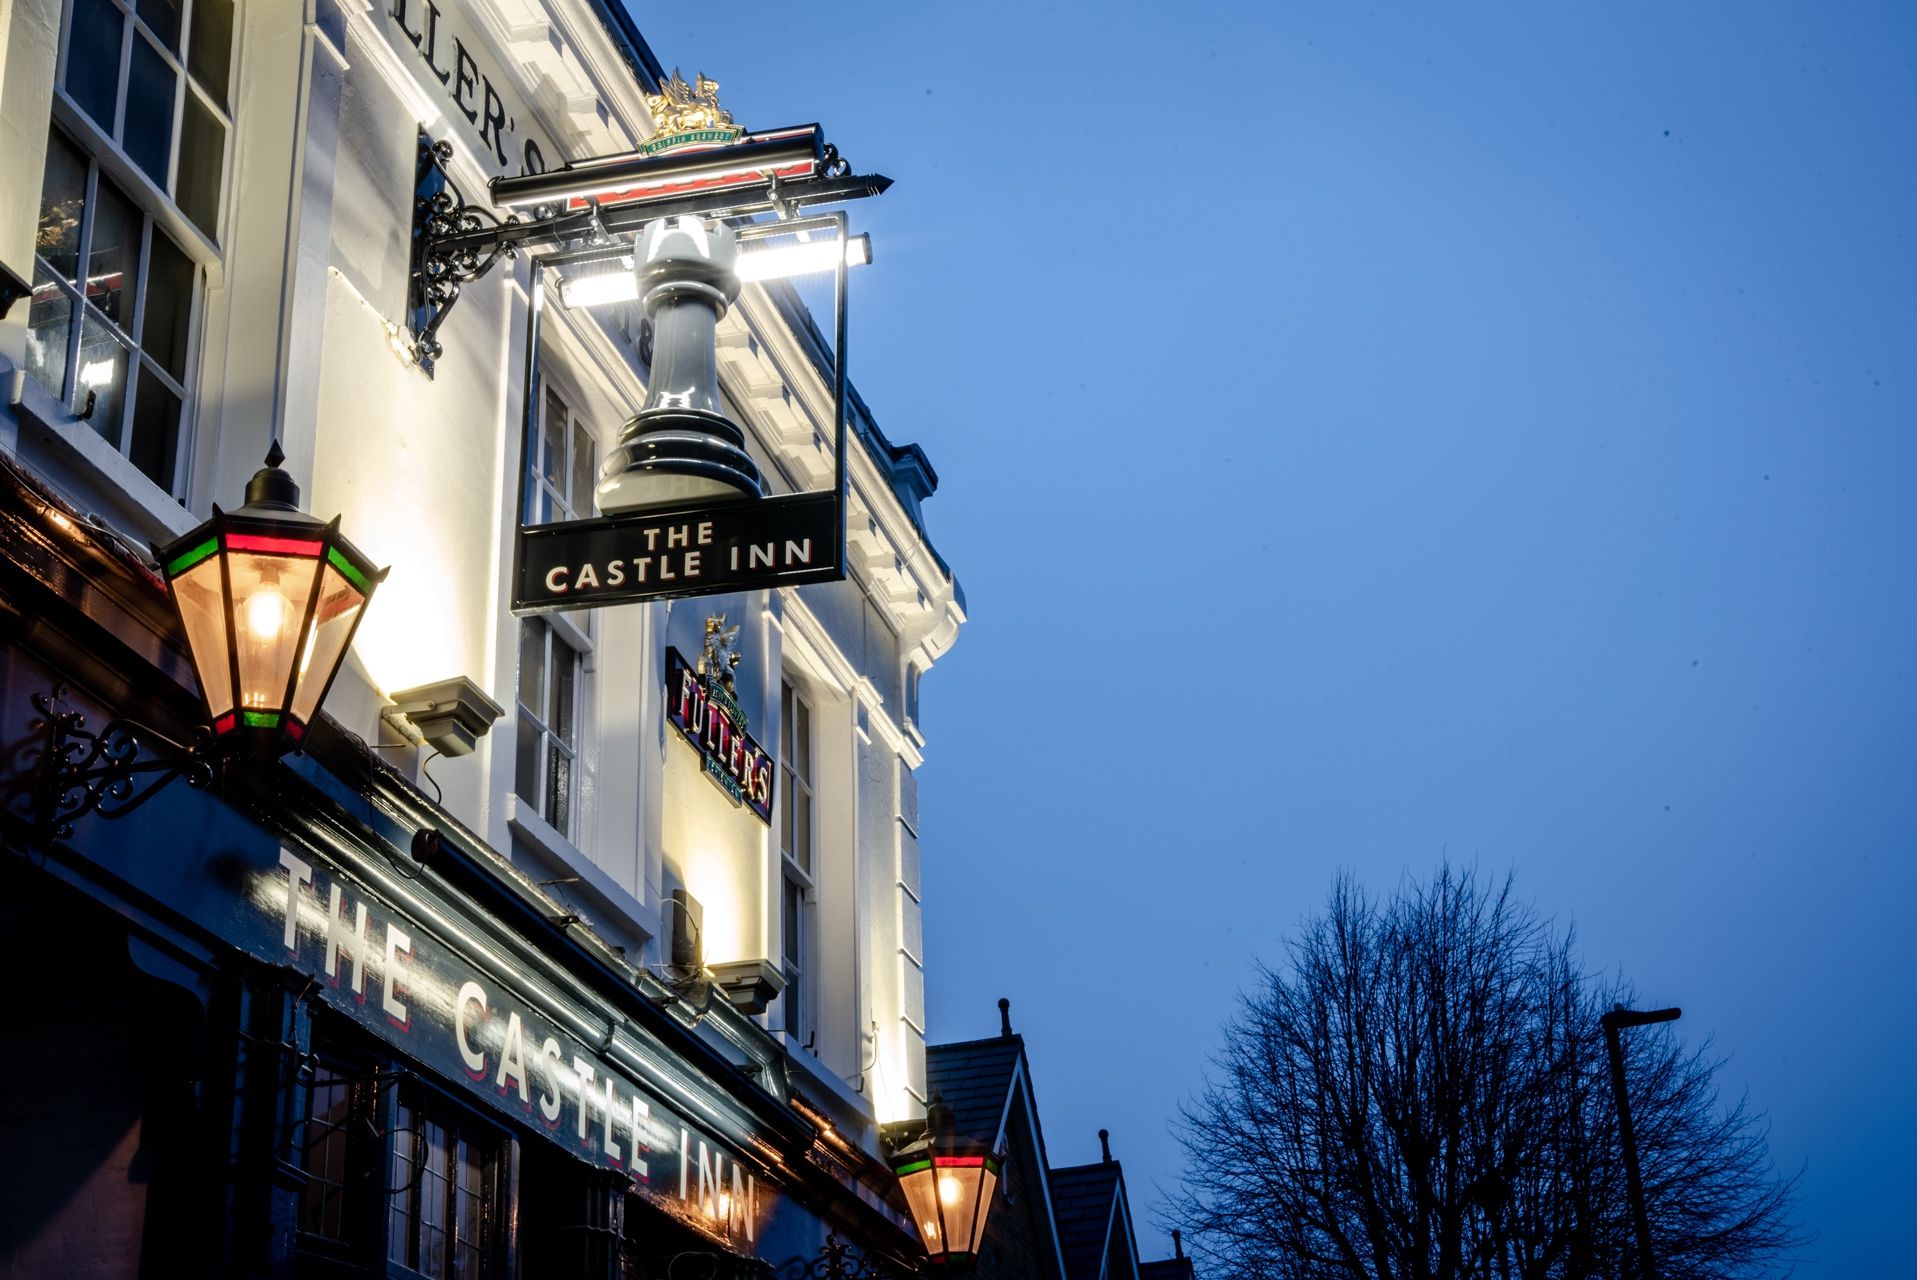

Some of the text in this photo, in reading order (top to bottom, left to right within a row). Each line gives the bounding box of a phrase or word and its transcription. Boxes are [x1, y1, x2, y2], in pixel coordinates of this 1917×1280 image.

[644, 521, 714, 551] THE
[545, 538, 812, 593] CASTLE INN
[279, 846, 755, 1243] THE CASTLE INN
